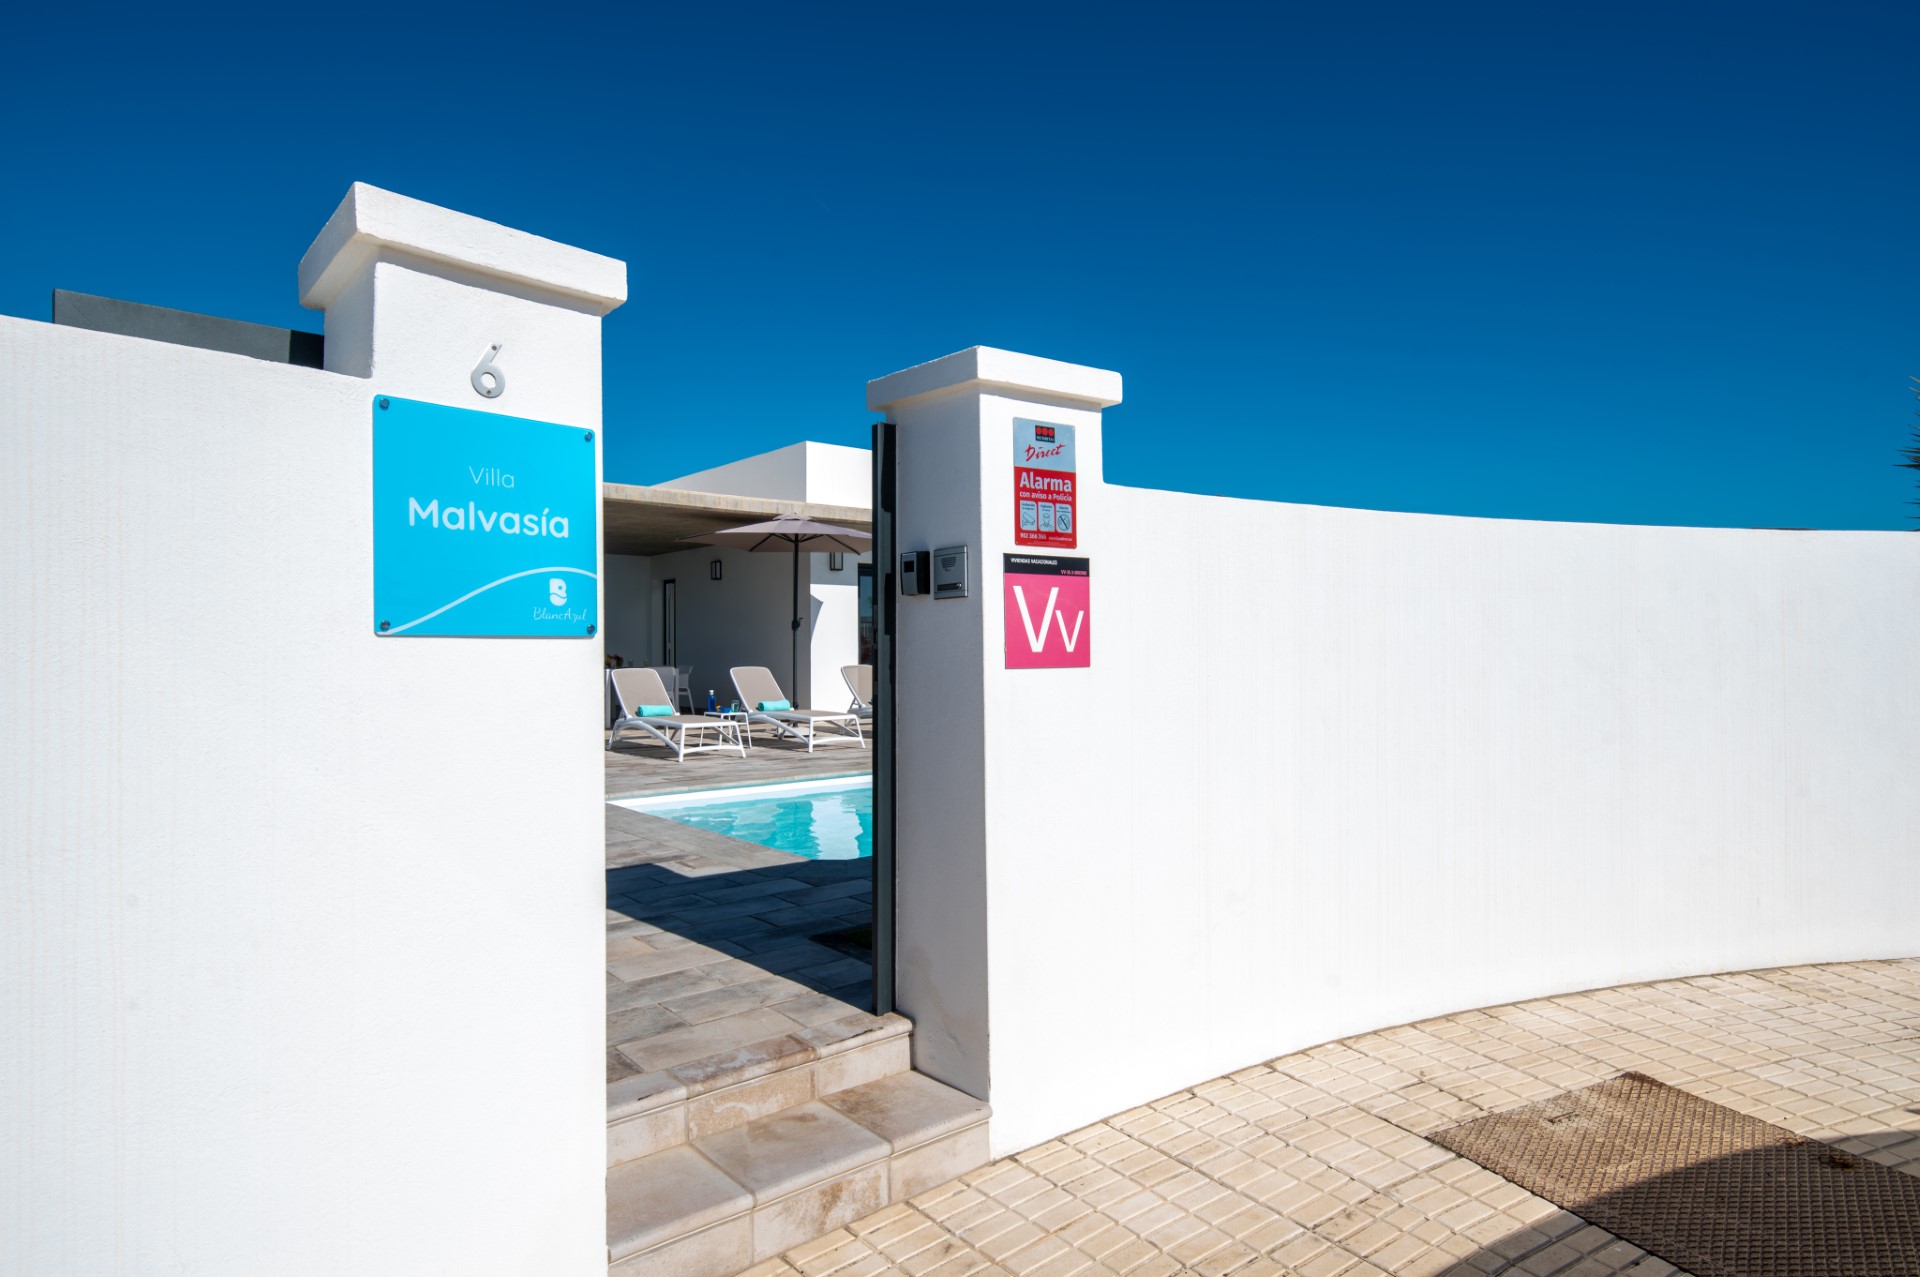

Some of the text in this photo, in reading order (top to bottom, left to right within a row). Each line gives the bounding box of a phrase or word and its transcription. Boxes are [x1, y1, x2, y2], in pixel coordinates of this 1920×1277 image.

[471, 342, 506, 398] 6
[1024, 443, 1067, 462] Direct
[469, 466, 515, 489] Villa
[1020, 471, 1072, 493] Alarma
[1031, 490, 1047, 499] aviso
[408, 496, 569, 538] Malvasía
